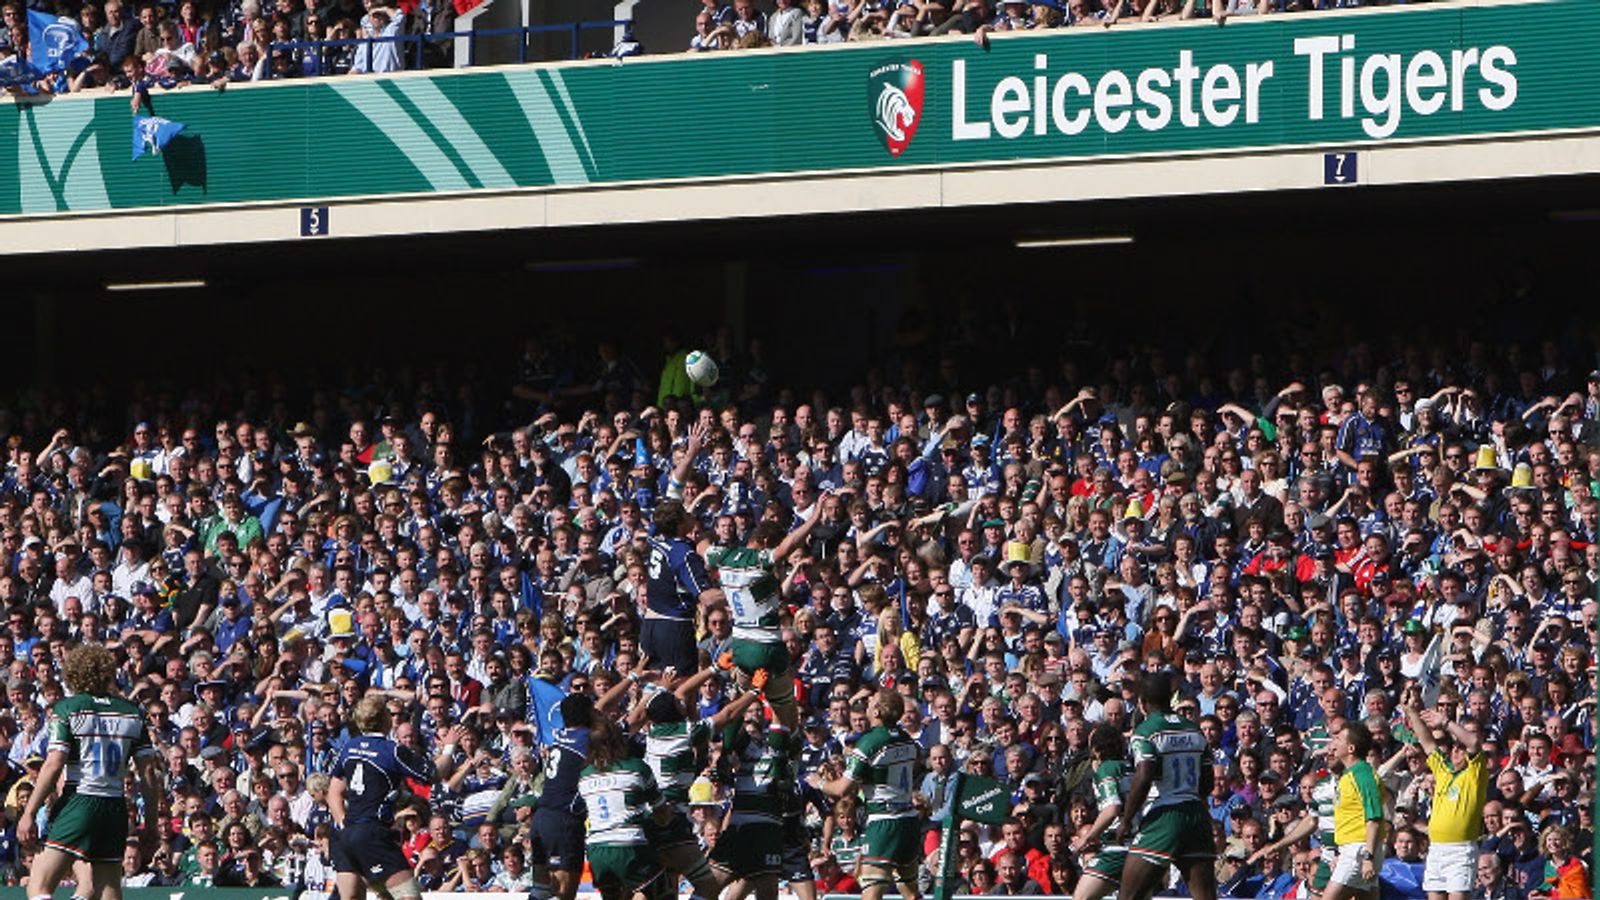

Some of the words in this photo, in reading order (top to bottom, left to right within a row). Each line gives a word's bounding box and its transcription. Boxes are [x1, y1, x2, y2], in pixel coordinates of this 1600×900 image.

[952, 51, 1274, 140] Leicester
[1294, 34, 1517, 139] Tigers
[1336, 154, 1345, 175] 7
[310, 207, 320, 228] 5
[649, 549, 664, 580] 5
[90, 742, 122, 778] 10
[546, 748, 562, 780] 3
[1172, 755, 1198, 790] 13
[350, 763, 366, 796] 4
